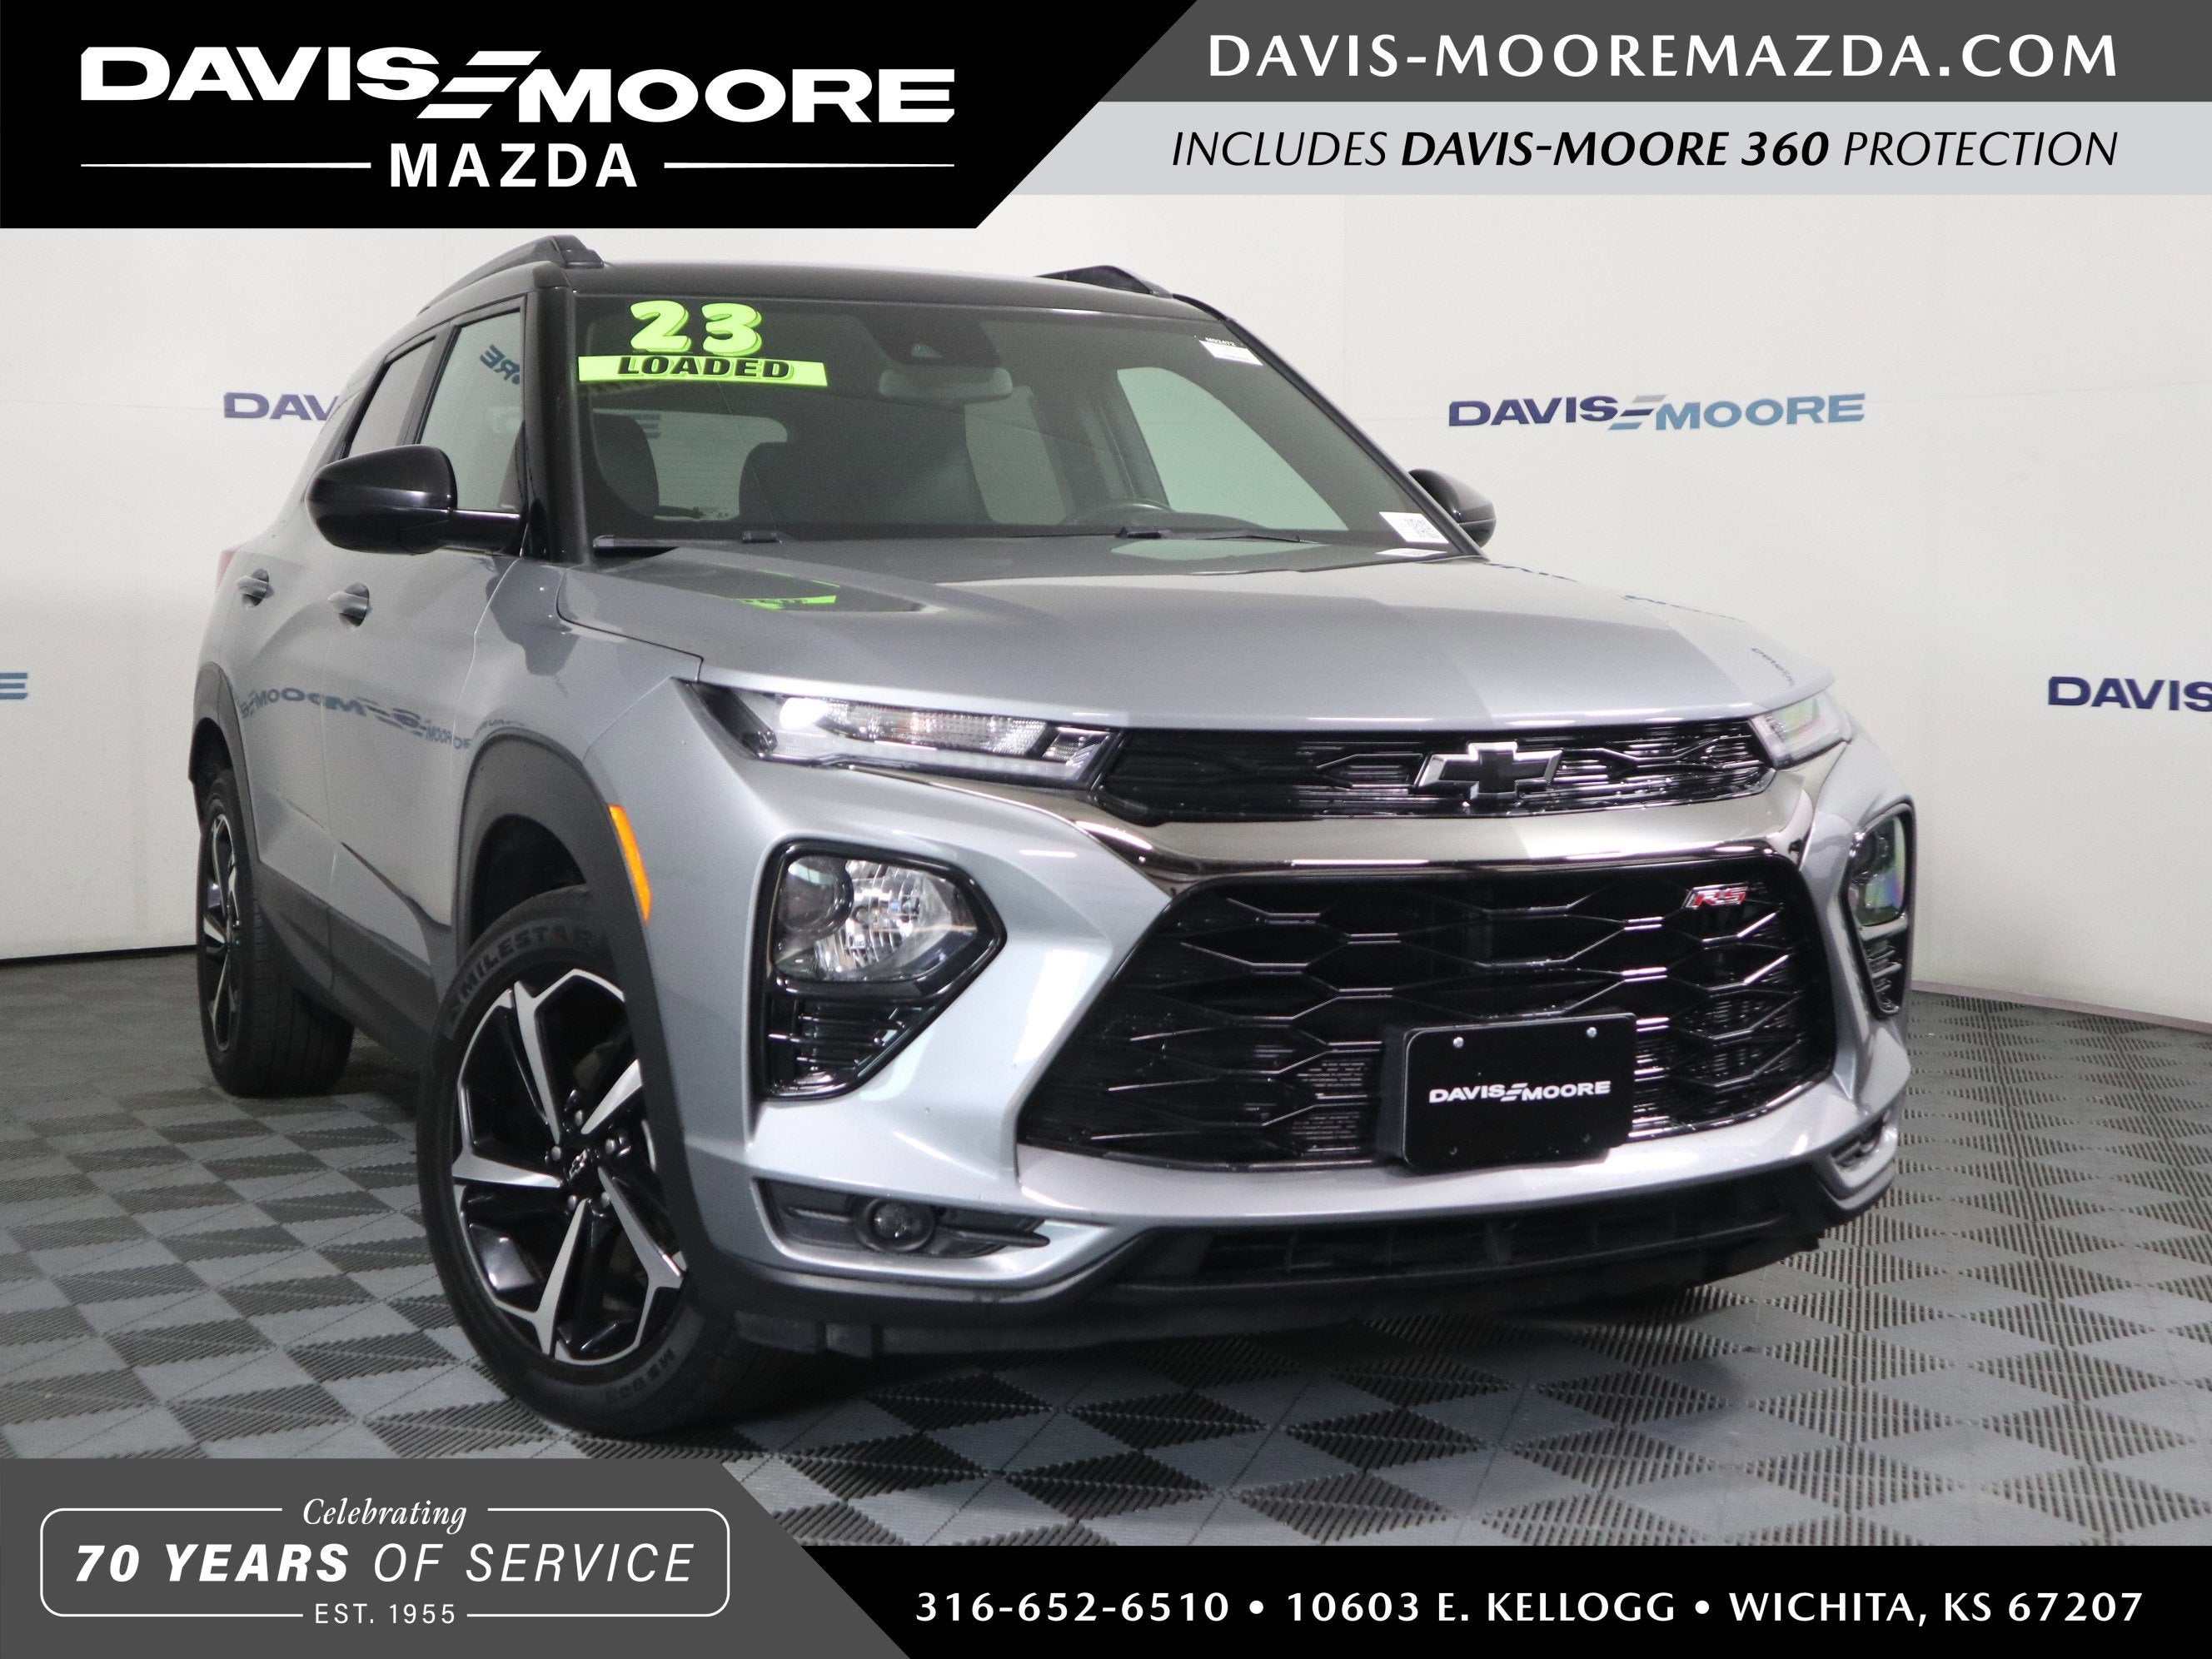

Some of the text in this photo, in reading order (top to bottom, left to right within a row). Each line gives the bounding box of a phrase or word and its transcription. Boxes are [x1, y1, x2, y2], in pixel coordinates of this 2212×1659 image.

[630, 300, 762, 356] 23
[617, 356, 794, 381] LOADED
[1448, 392, 1866, 431] DAVIS MOORE
[2048, 675, 2212, 712] DAVIS
[1684, 884, 1748, 909] RS
[459, 924, 593, 1000] MILESTAR
[1428, 1080, 1612, 1104] DAVIS MOORE
